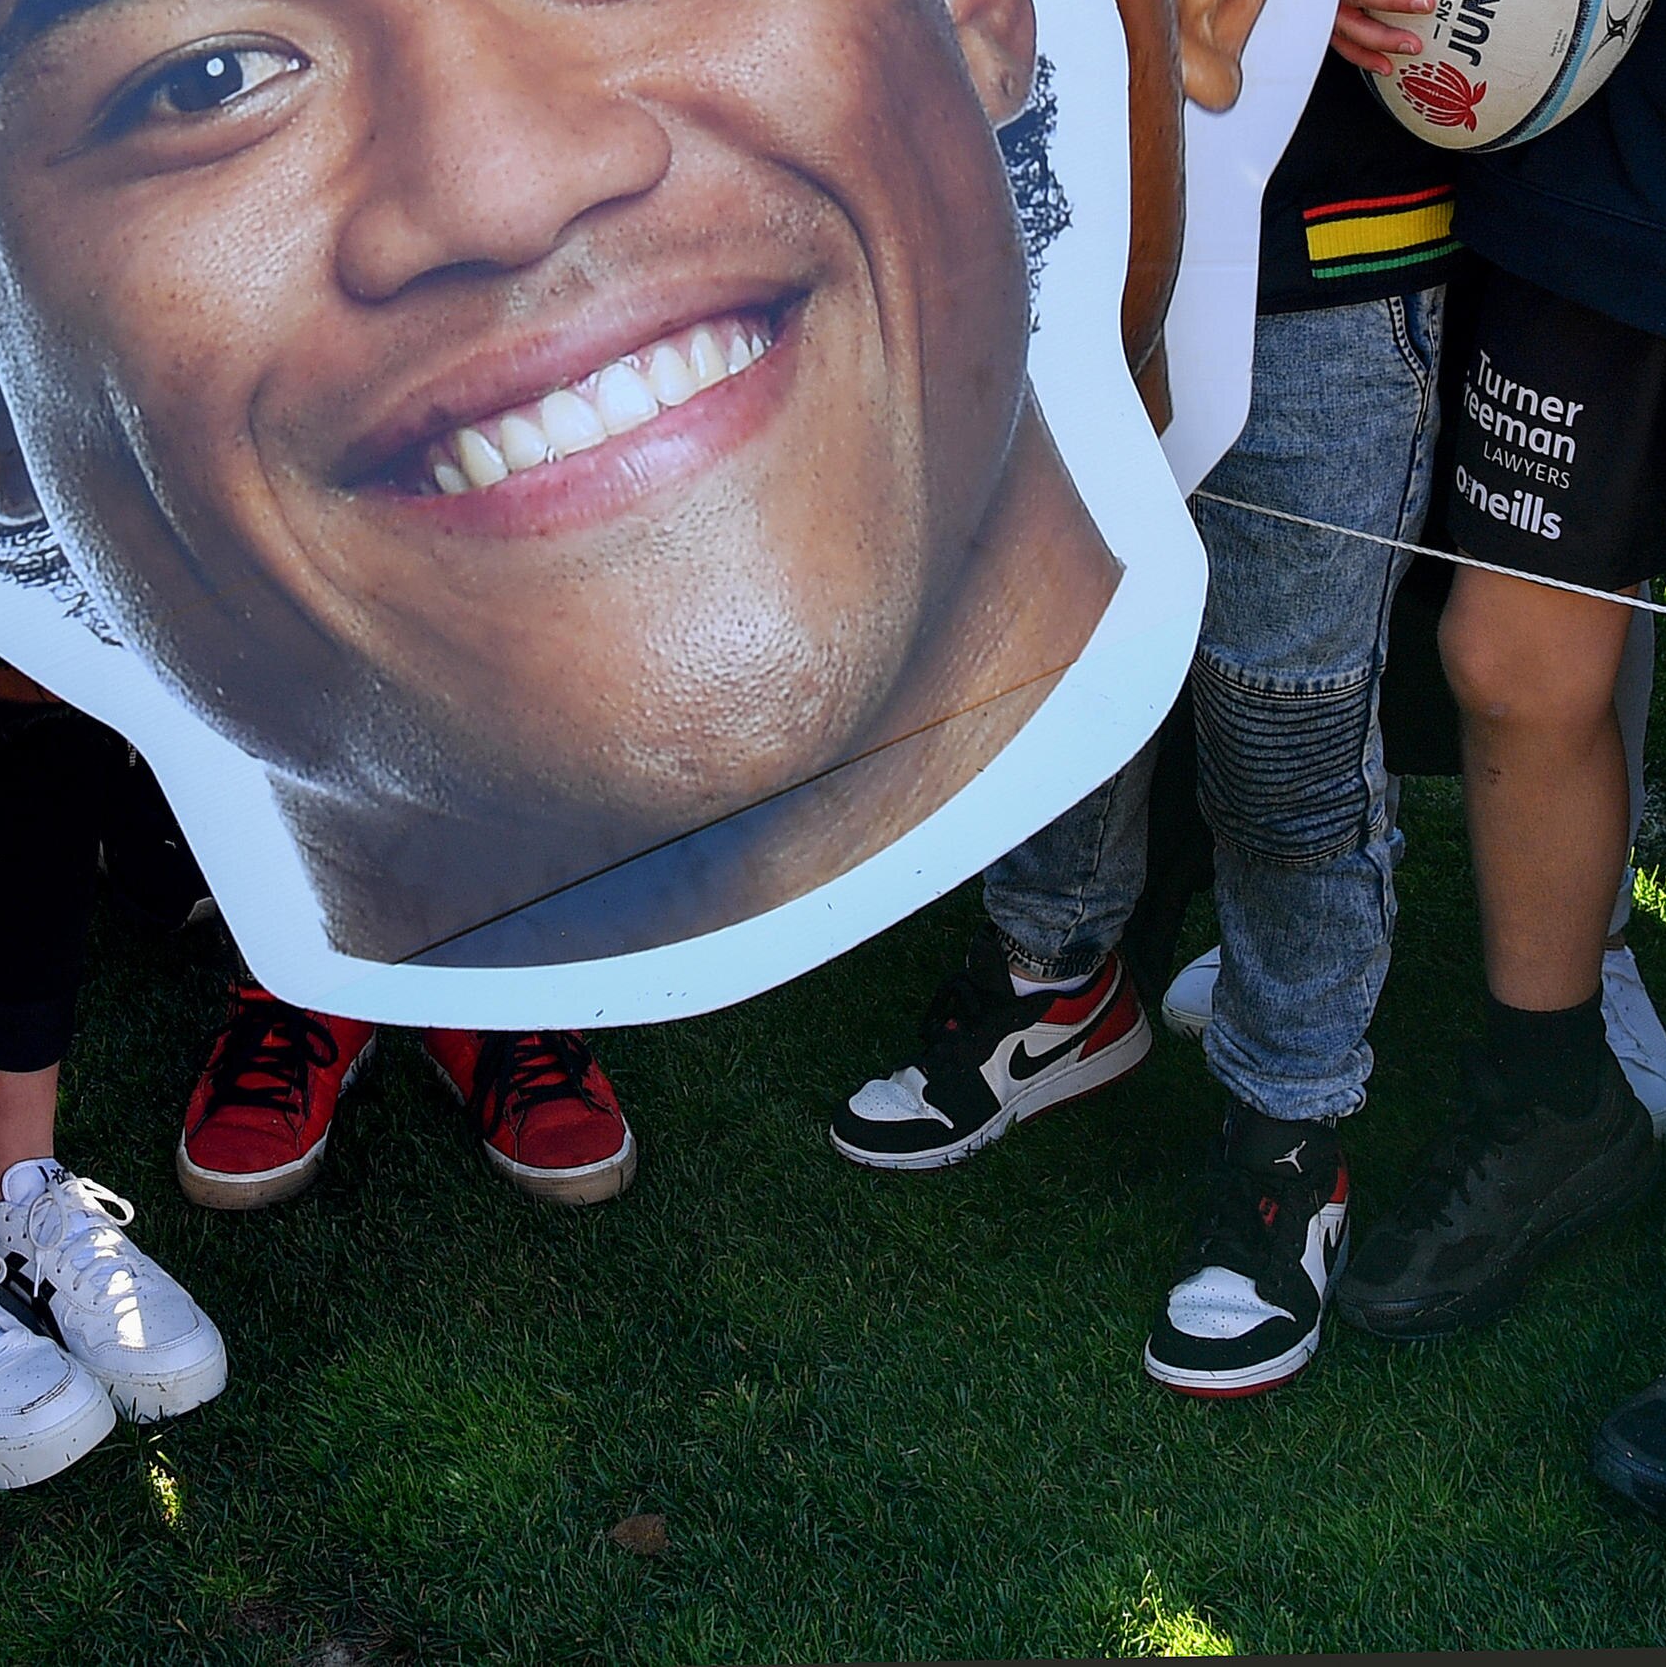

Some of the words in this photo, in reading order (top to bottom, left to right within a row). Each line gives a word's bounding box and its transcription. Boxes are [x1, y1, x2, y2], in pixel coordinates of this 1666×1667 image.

[1464, 383, 1577, 464] reeman
[1477, 349, 1584, 427] Turner
[1483, 441, 1572, 490] LAWYERS
